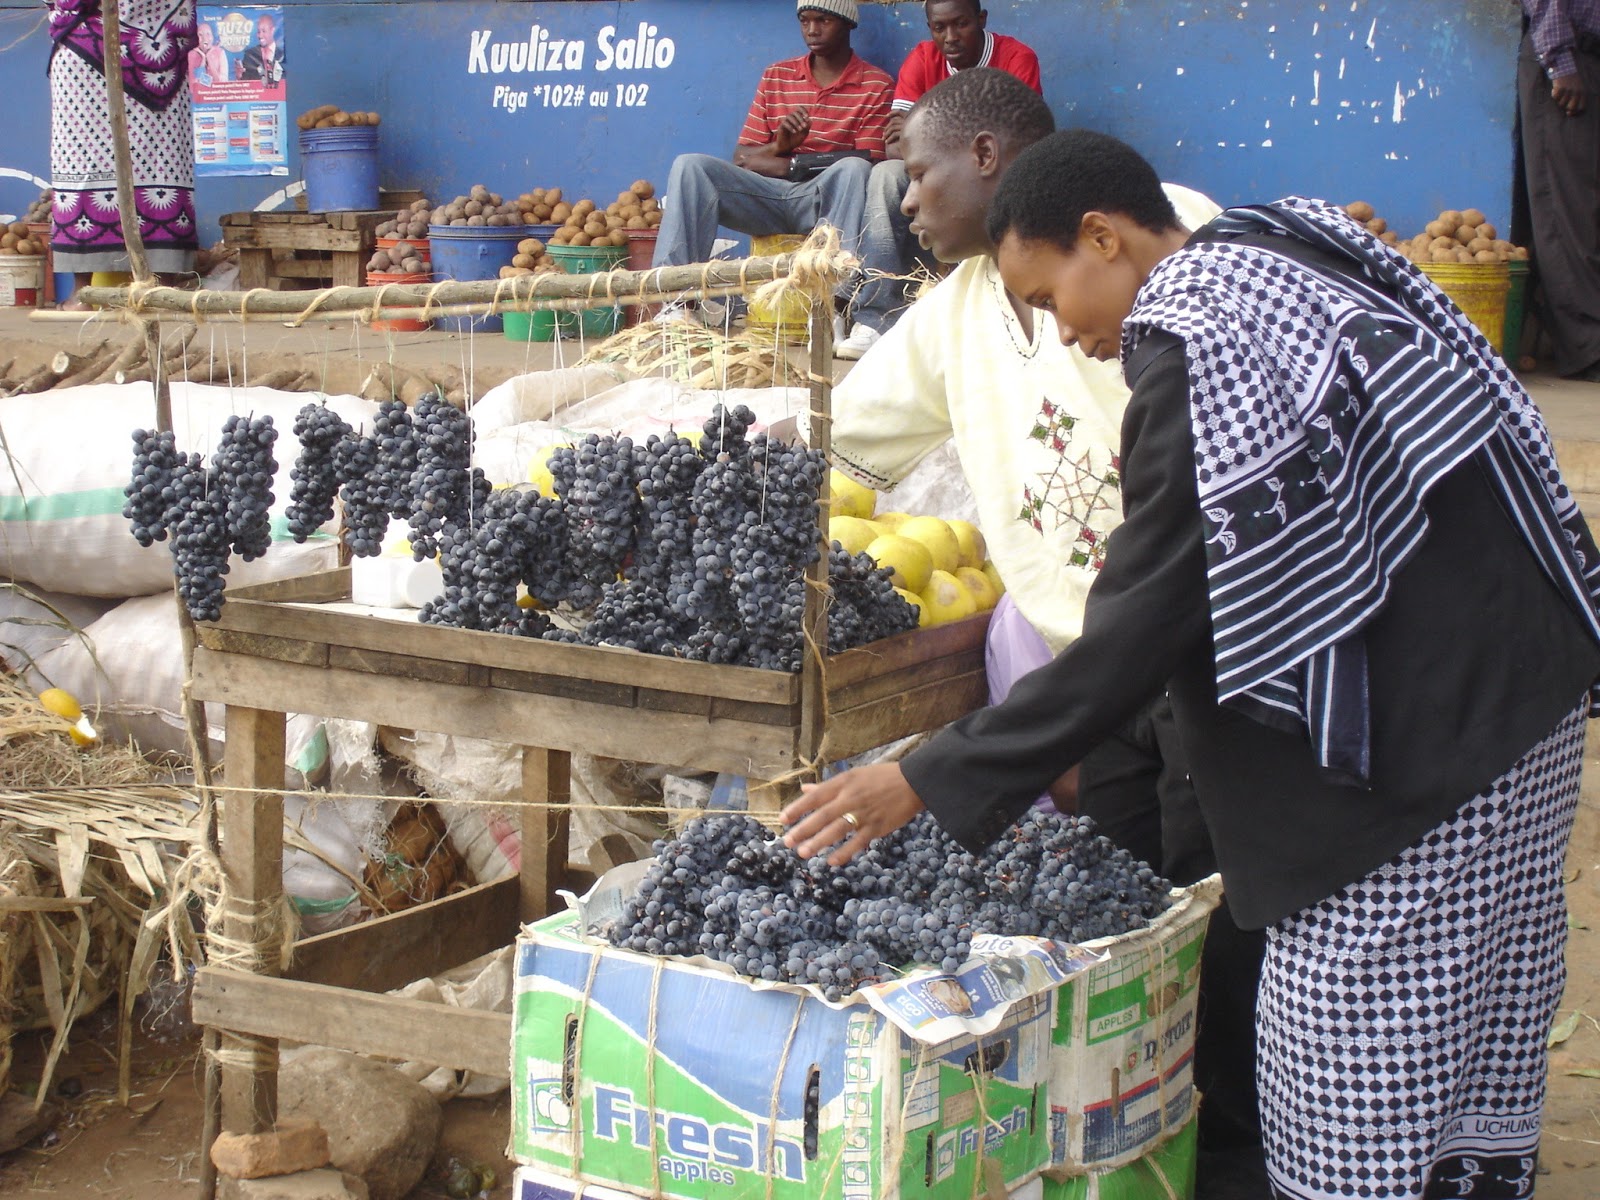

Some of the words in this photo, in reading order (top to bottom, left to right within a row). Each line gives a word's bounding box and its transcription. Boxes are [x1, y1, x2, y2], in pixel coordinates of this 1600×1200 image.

[217, 20, 254, 36] TUZO
[468, 24, 585, 74] Kuuliza
[595, 22, 675, 71] Salio
[493, 85, 528, 113] Piga
[590, 90, 608, 107] au
[616, 84, 649, 107] 102
[1097, 1010, 1133, 1032] APPLES
[594, 1085, 805, 1183] Fresh
[959, 1106, 1027, 1158] Fresh
[660, 1157, 735, 1185] apples
